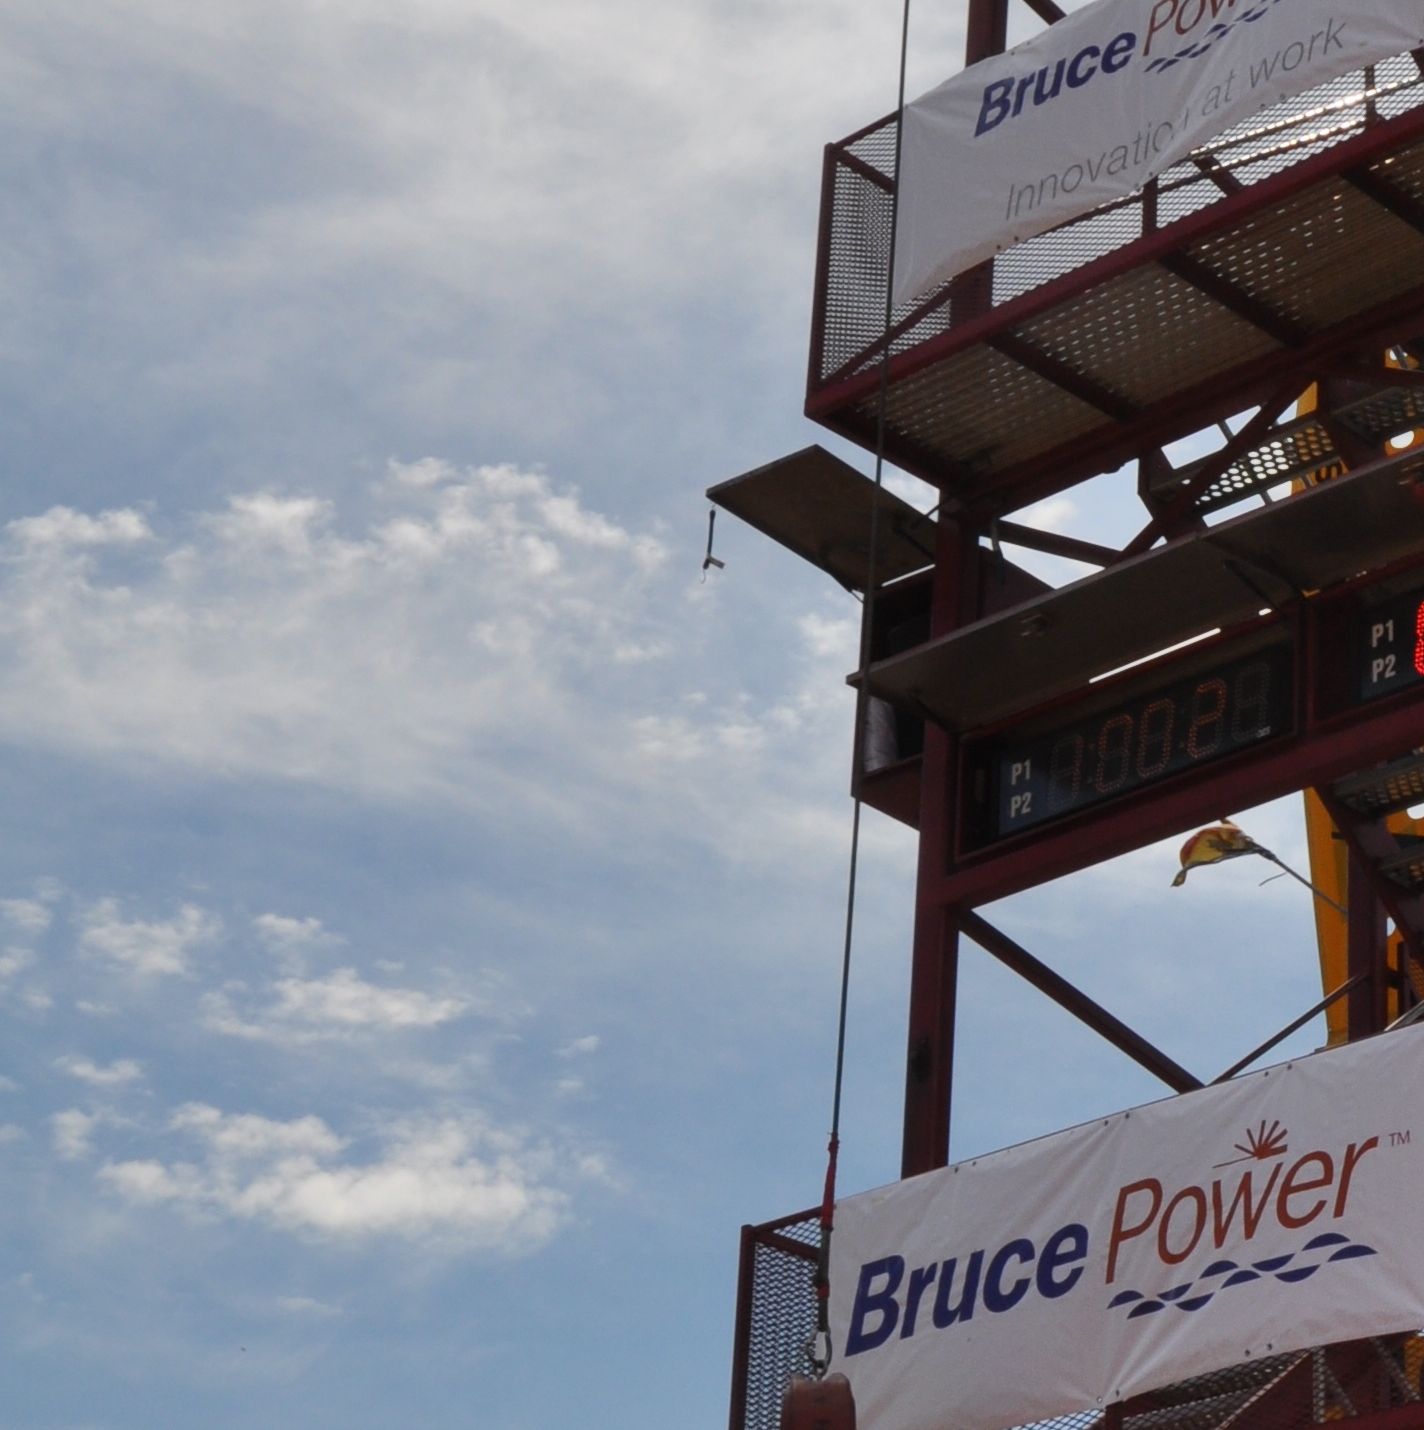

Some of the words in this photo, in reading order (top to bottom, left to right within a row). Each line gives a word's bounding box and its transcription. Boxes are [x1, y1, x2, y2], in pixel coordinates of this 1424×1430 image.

[1202, 68, 1236, 117] at
[1248, 17, 1347, 90] work
[974, 31, 1137, 138] Bruce
[1371, 619, 1394, 648] P1
[1372, 655, 1396, 683] P2
[1010, 759, 1031, 786] P1
[1009, 791, 1032, 819] P2
[844, 1223, 1089, 1358] Bruce
[1105, 1135, 1379, 1285] Power
[1389, 1129, 1411, 1147] TM
